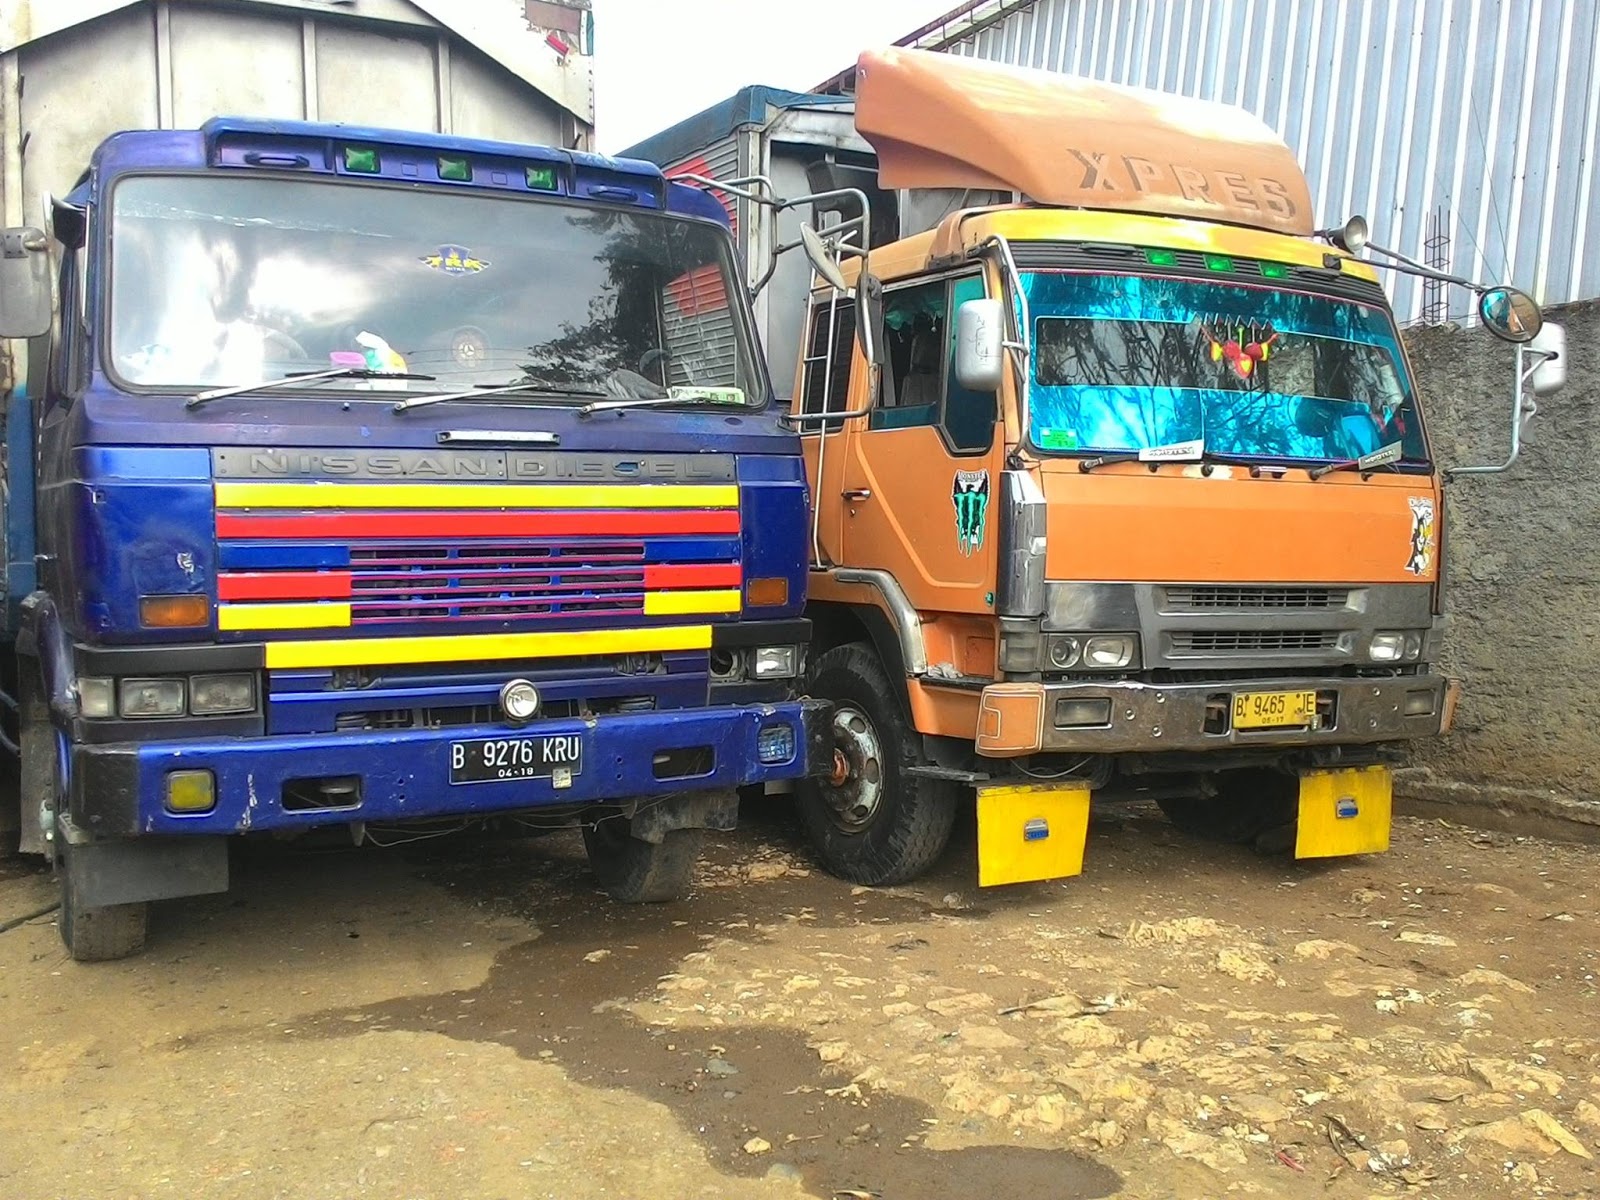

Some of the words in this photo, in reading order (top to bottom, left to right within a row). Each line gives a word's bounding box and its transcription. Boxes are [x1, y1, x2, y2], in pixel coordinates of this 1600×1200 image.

[1066, 148, 1297, 220] XPRES
[250, 453, 489, 477] NISSAN
[515, 457, 713, 478] DIESEL
[1235, 698, 1243, 716] B
[1254, 695, 1286, 715] 9465
[452, 744, 465, 769] B
[483, 740, 533, 767] 9276
[542, 736, 579, 762] KRU
